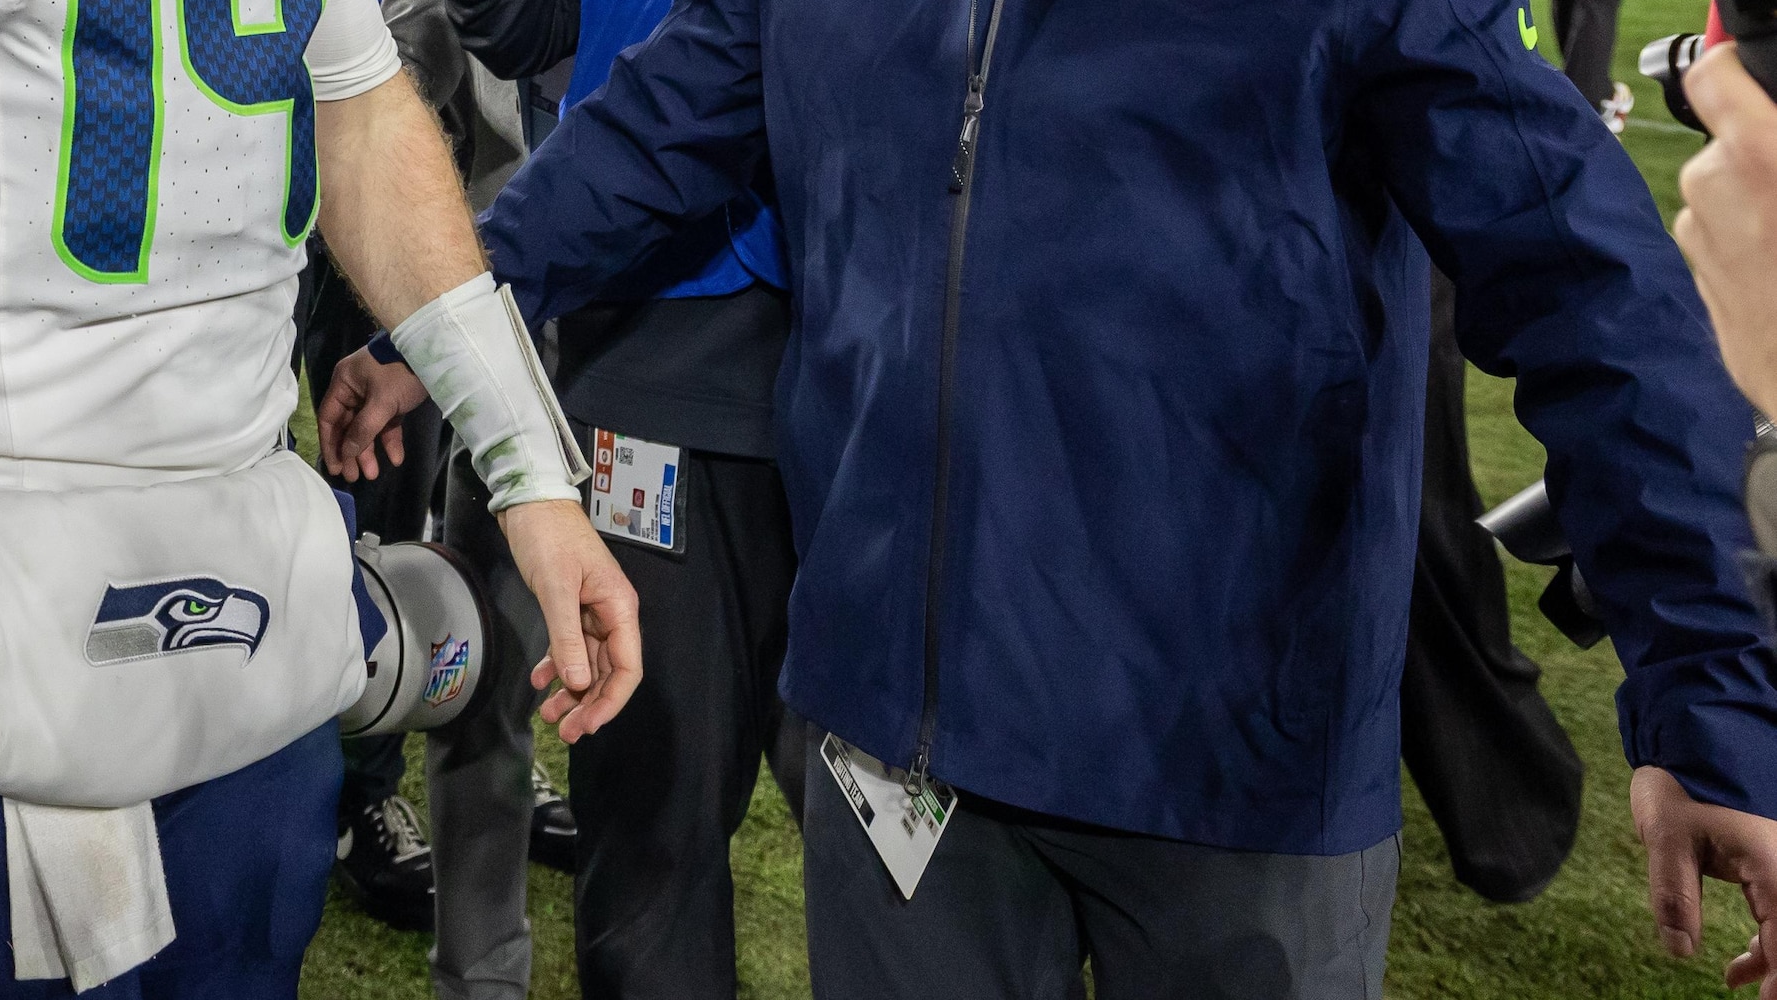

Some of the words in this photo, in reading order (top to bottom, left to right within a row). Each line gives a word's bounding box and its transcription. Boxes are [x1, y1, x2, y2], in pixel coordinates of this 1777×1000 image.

[661, 484, 673, 513] OFFICIAL
[660, 513, 671, 527] NFL
[425, 667, 461, 701] NFL
[849, 781, 865, 810] TEAM
